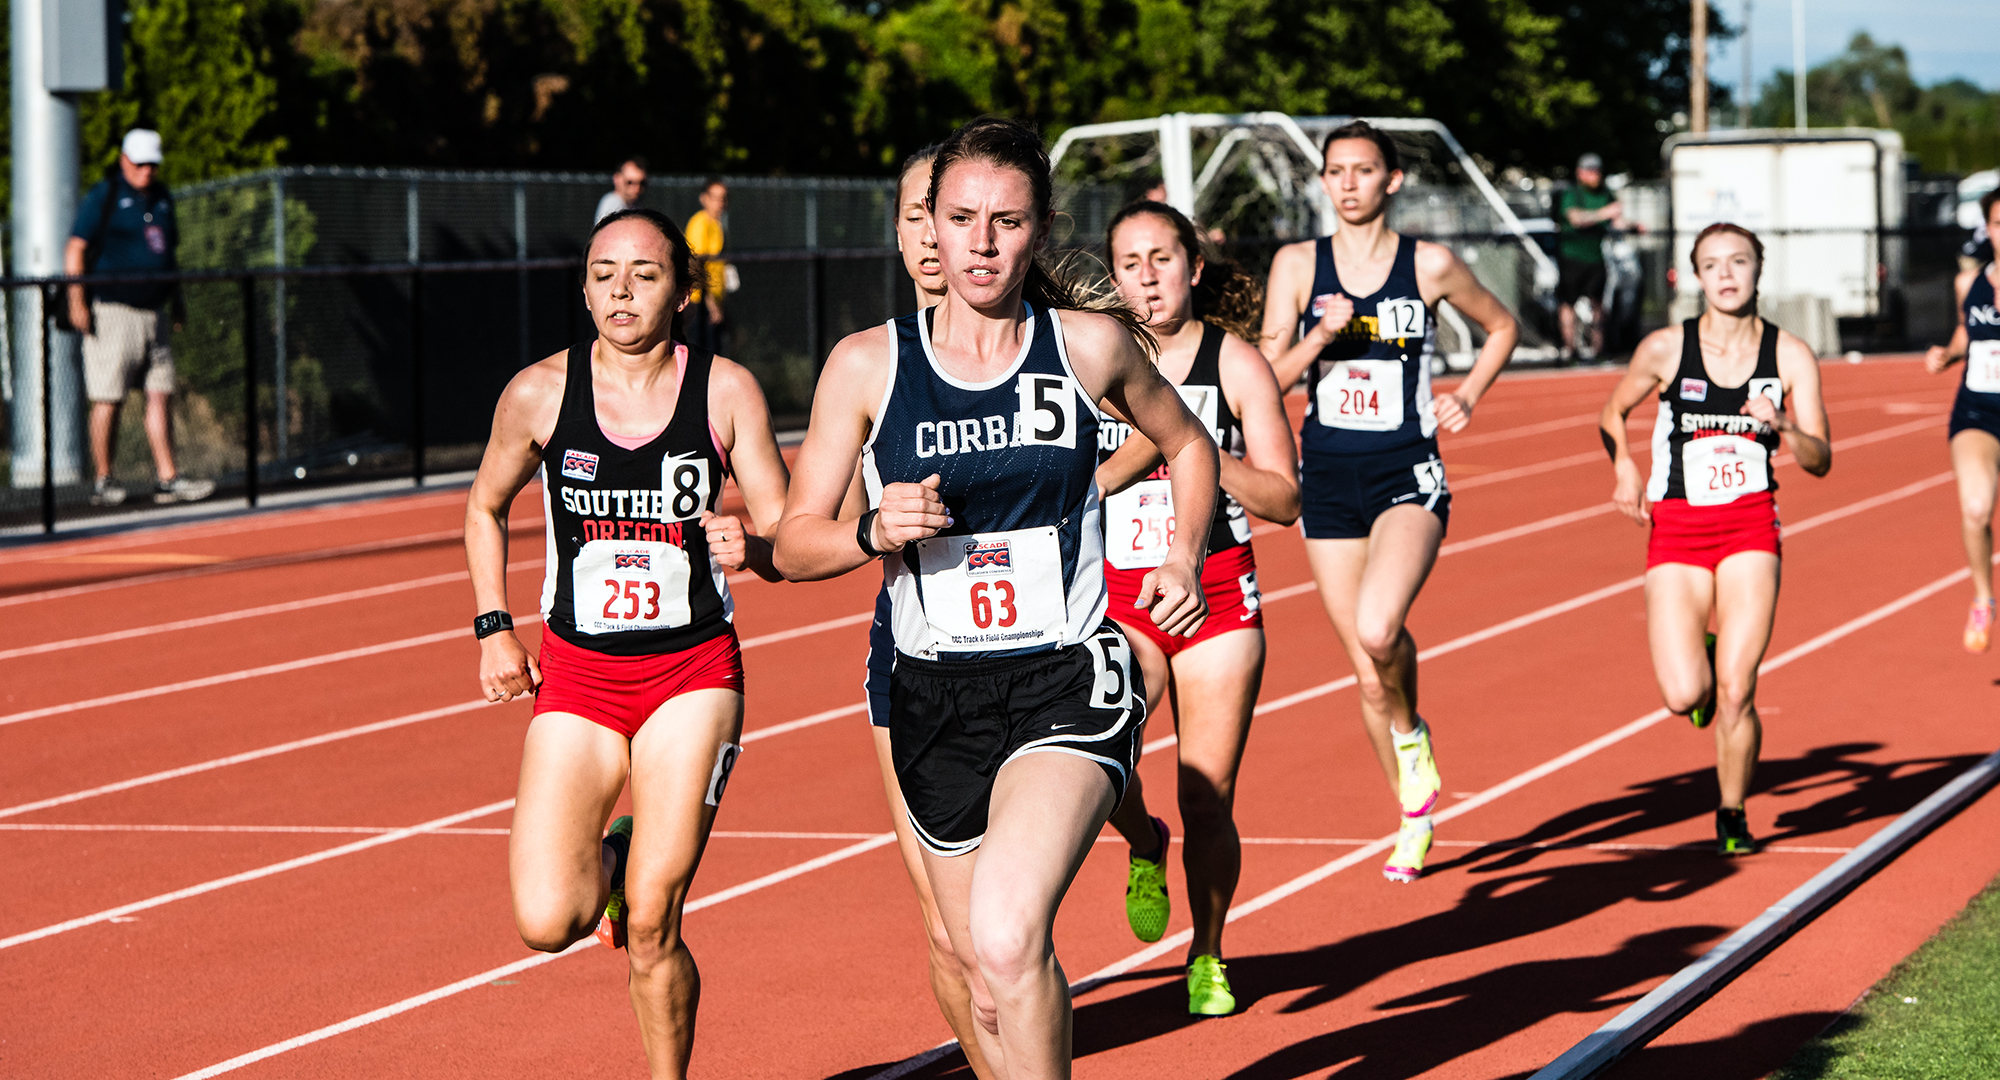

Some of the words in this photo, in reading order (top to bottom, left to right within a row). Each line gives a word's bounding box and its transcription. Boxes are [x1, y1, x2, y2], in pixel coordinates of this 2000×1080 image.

[1388, 304, 1416, 333] 12
[1034, 378, 1065, 441] 5
[1340, 389, 1379, 416] 204
[566, 451, 597, 461] CASCADE
[566, 458, 595, 473] CCC
[1708, 462, 1746, 490] 265
[672, 464, 701, 518] 8
[965, 541, 1009, 551] CASCADE
[1132, 516, 1175, 552] 258
[616, 555, 650, 568] CCC
[968, 550, 1009, 566] CCC
[603, 579, 660, 620] 253
[970, 580, 1017, 629] 63
[963, 635, 980, 644] Track
[1097, 637, 1125, 705] 5
[714, 747, 735, 804] 8
